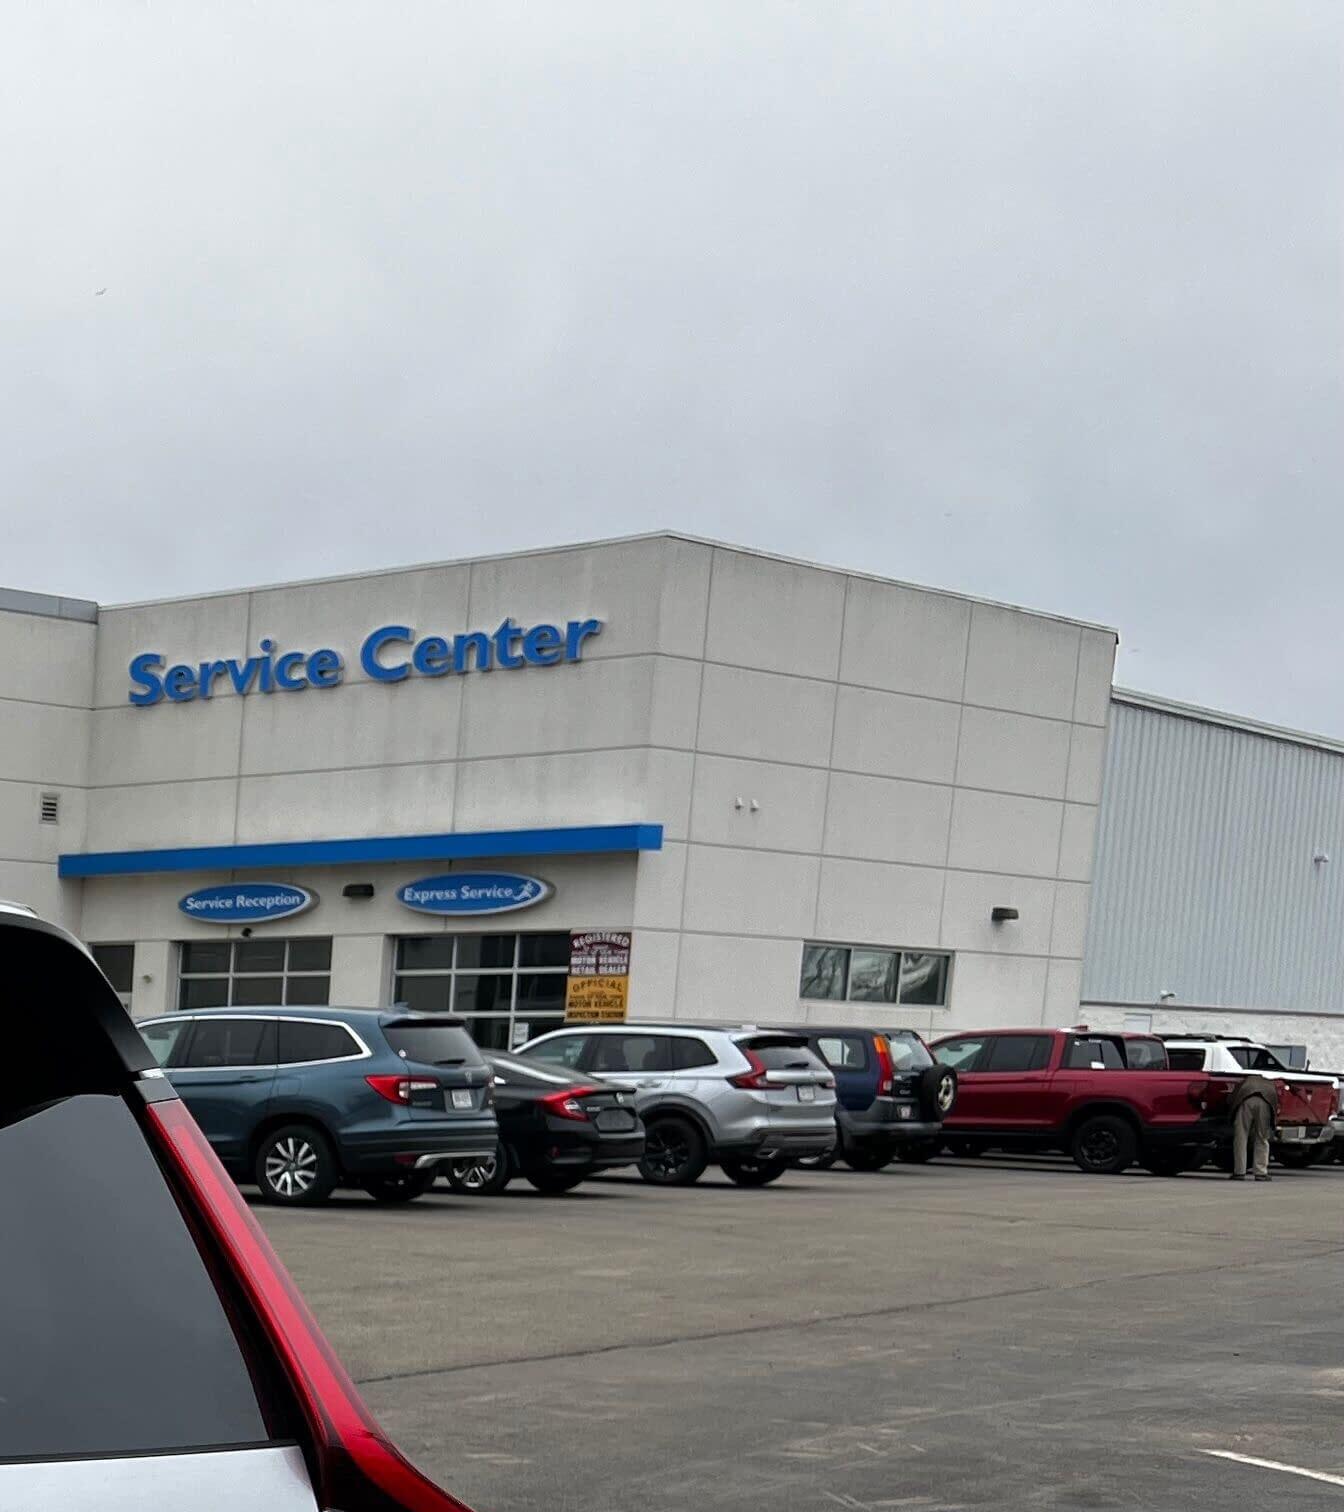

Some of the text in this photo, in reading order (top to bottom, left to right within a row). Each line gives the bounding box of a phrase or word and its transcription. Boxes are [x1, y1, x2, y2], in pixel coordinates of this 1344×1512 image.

[128, 616, 602, 707] Service Center
[186, 893, 300, 912] Service Reception
[403, 885, 513, 903] Express Service
[572, 979, 624, 993] OFFICIAL
